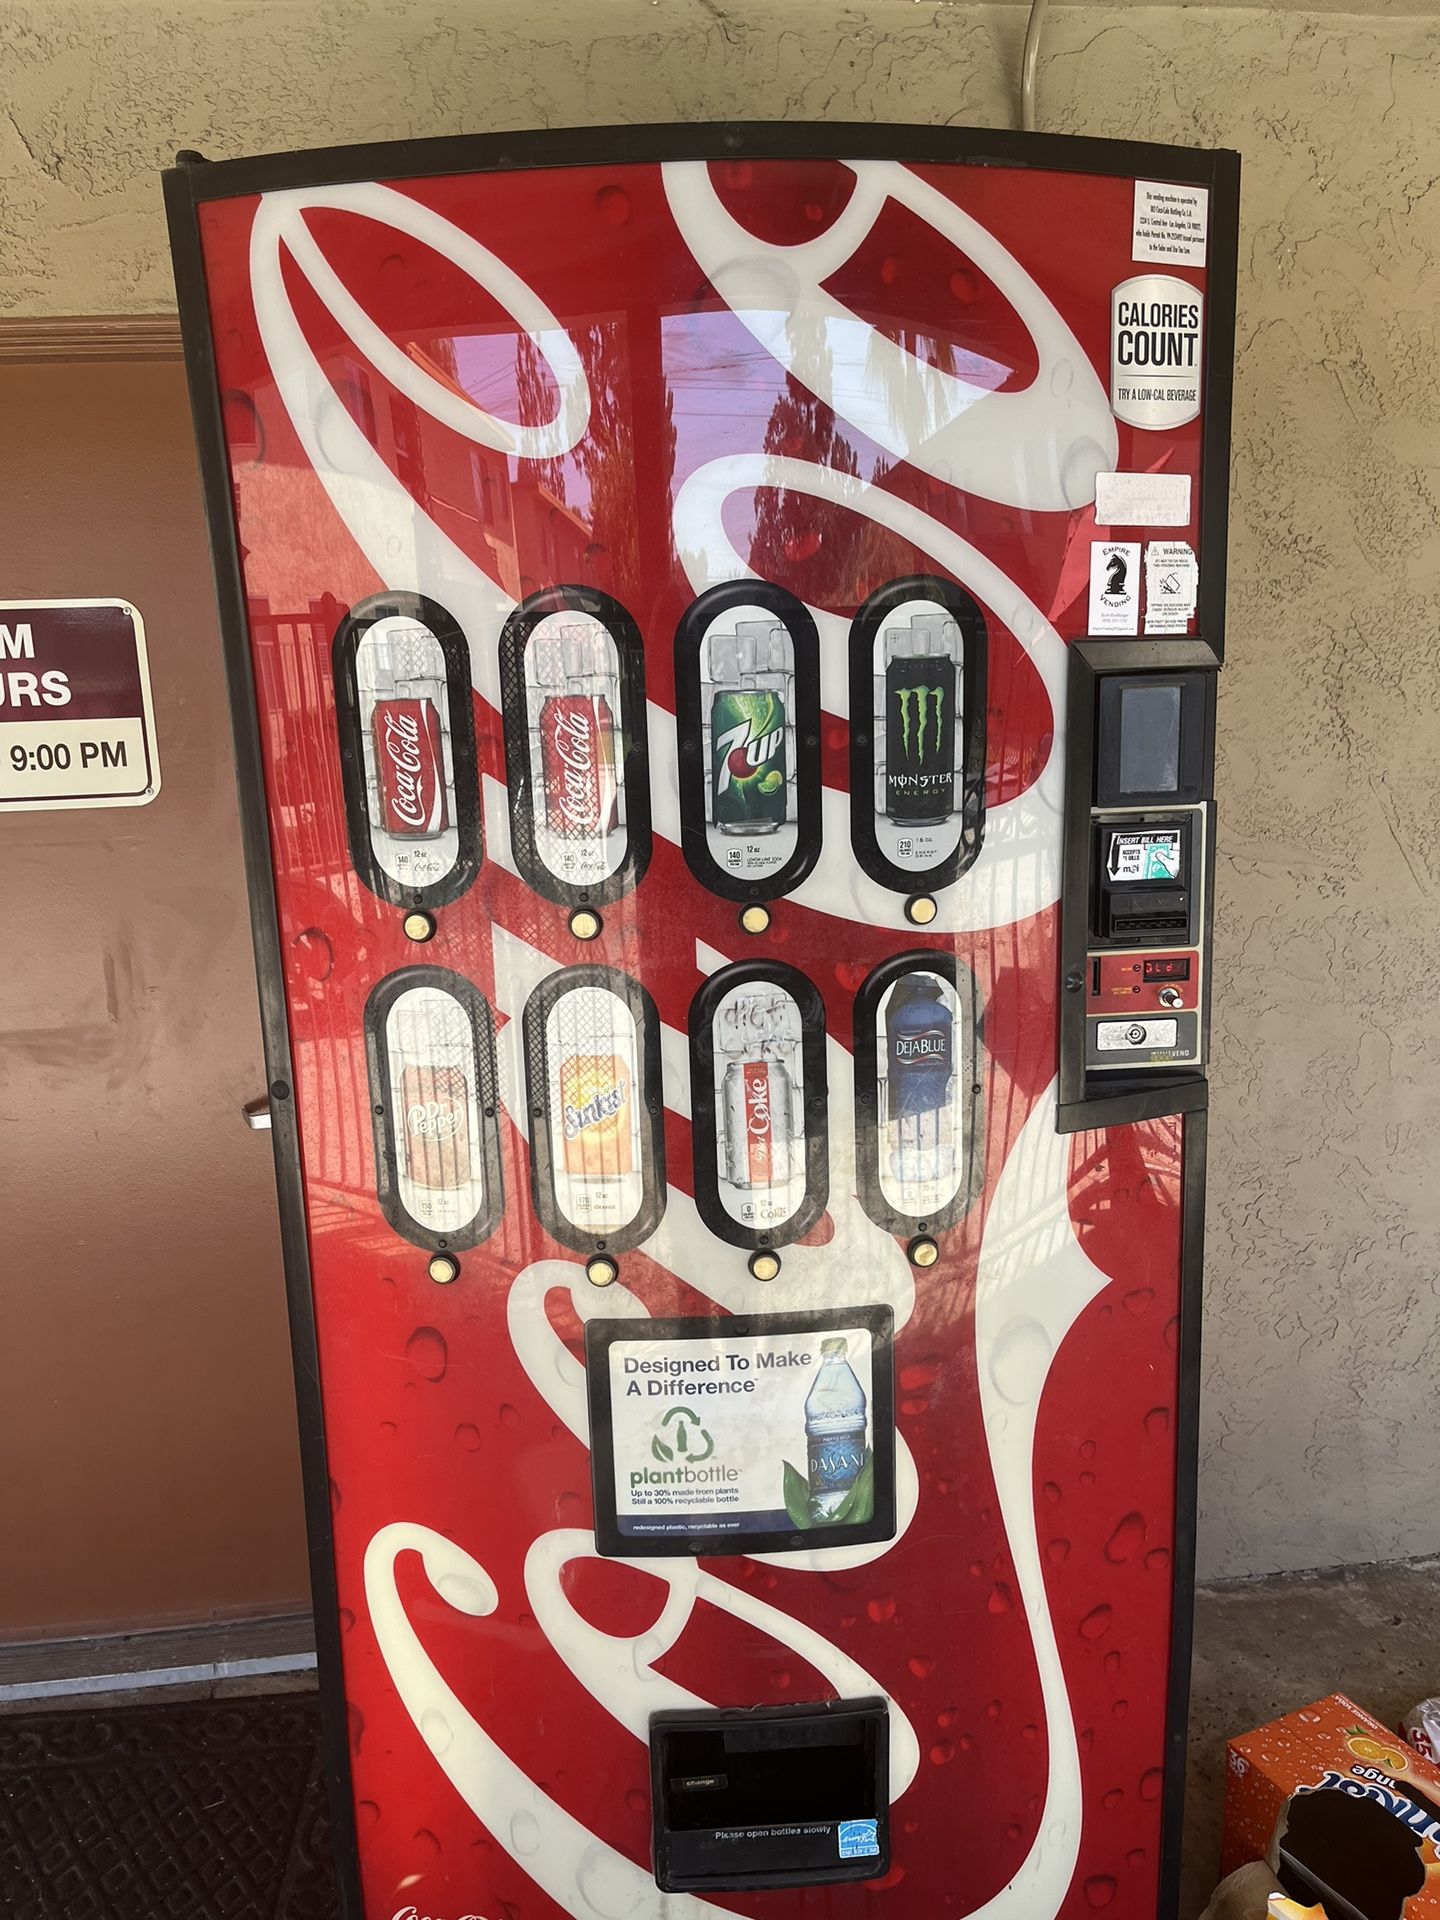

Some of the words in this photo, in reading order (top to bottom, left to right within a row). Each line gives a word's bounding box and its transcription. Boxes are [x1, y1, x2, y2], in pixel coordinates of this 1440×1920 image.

[1118, 302, 1198, 329] CALORIES
[1117, 330, 1198, 367] COUNT
[1118, 388, 1130, 400] TRY
[1132, 389, 1136, 400] A
[1138, 388, 1165, 401] LOW-CAL
[1167, 389, 1197, 402] BEVERAGE
[1102, 546, 1131, 556] EMPIRE
[1100, 593, 1131, 608] VENDING
[10, 743, 71, 771] 9:00
[80, 741, 128, 768] PM
[384, 708, 427, 827] Coca-Cola
[553, 706, 594, 826] Coca-Cola
[888, 772, 952, 788] MONSTER
[1116, 836, 1139, 844] INSERT
[1156, 835, 1173, 843] HERE
[729, 851, 740, 859] 140
[747, 845, 753, 853] 12
[426, 1100, 448, 1119] Dr
[564, 1079, 627, 1140] Sunkist
[747, 1075, 771, 1135] Coke
[408, 1104, 461, 1135] Pepper
[624, 1355, 720, 1377] Designed
[726, 1354, 750, 1370] To
[756, 1351, 812, 1369] Make
[626, 1380, 642, 1396] A
[647, 1379, 756, 1396] Difference
[811, 1453, 863, 1473] DASANI
[630, 1464, 739, 1489] plantbottle
[631, 1490, 643, 1498] Up
[672, 1488, 694, 1496] made
[696, 1488, 714, 1496] from
[715, 1487, 739, 1497] plants
[675, 1496, 714, 1505] recyclable
[688, 1522, 718, 1530] recyclable
[686, 1778, 715, 1787] change
[715, 1830, 744, 1839] Please
[746, 1829, 769, 1838] open
[771, 1827, 801, 1836] bottles
[804, 1826, 831, 1835] slowly
